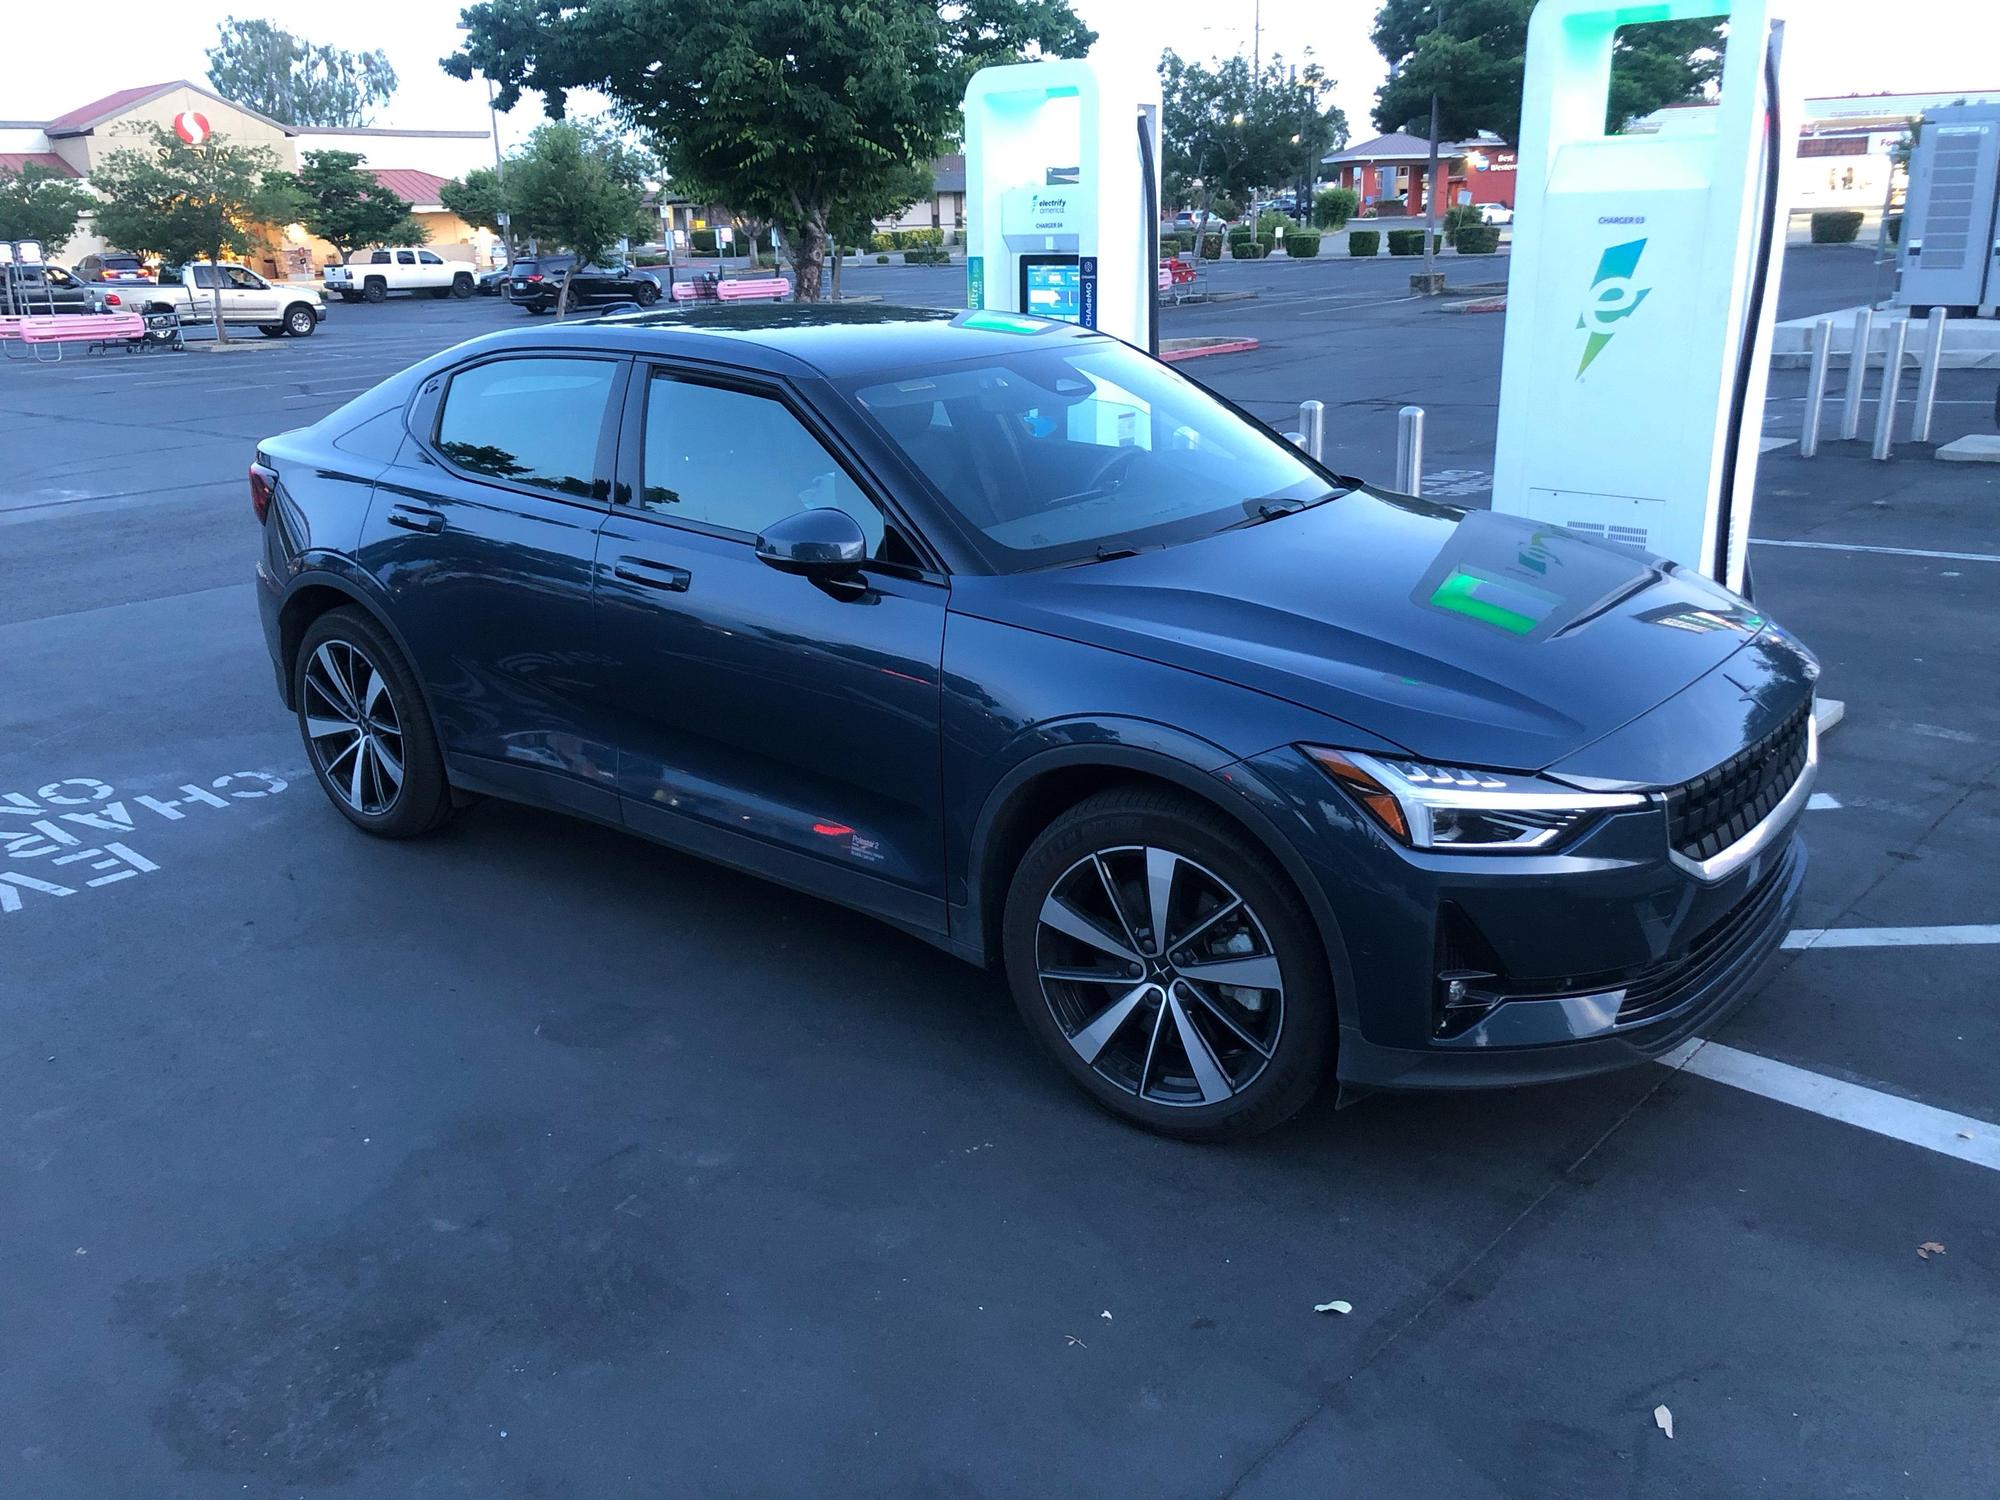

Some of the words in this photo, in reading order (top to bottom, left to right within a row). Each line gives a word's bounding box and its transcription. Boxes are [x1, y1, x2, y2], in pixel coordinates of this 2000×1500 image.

[1497, 154, 1514, 162] Best
[1039, 199, 1066, 208] electrify
[1598, 216, 1634, 224] CHARGER
[970, 281, 979, 310] Ultra
